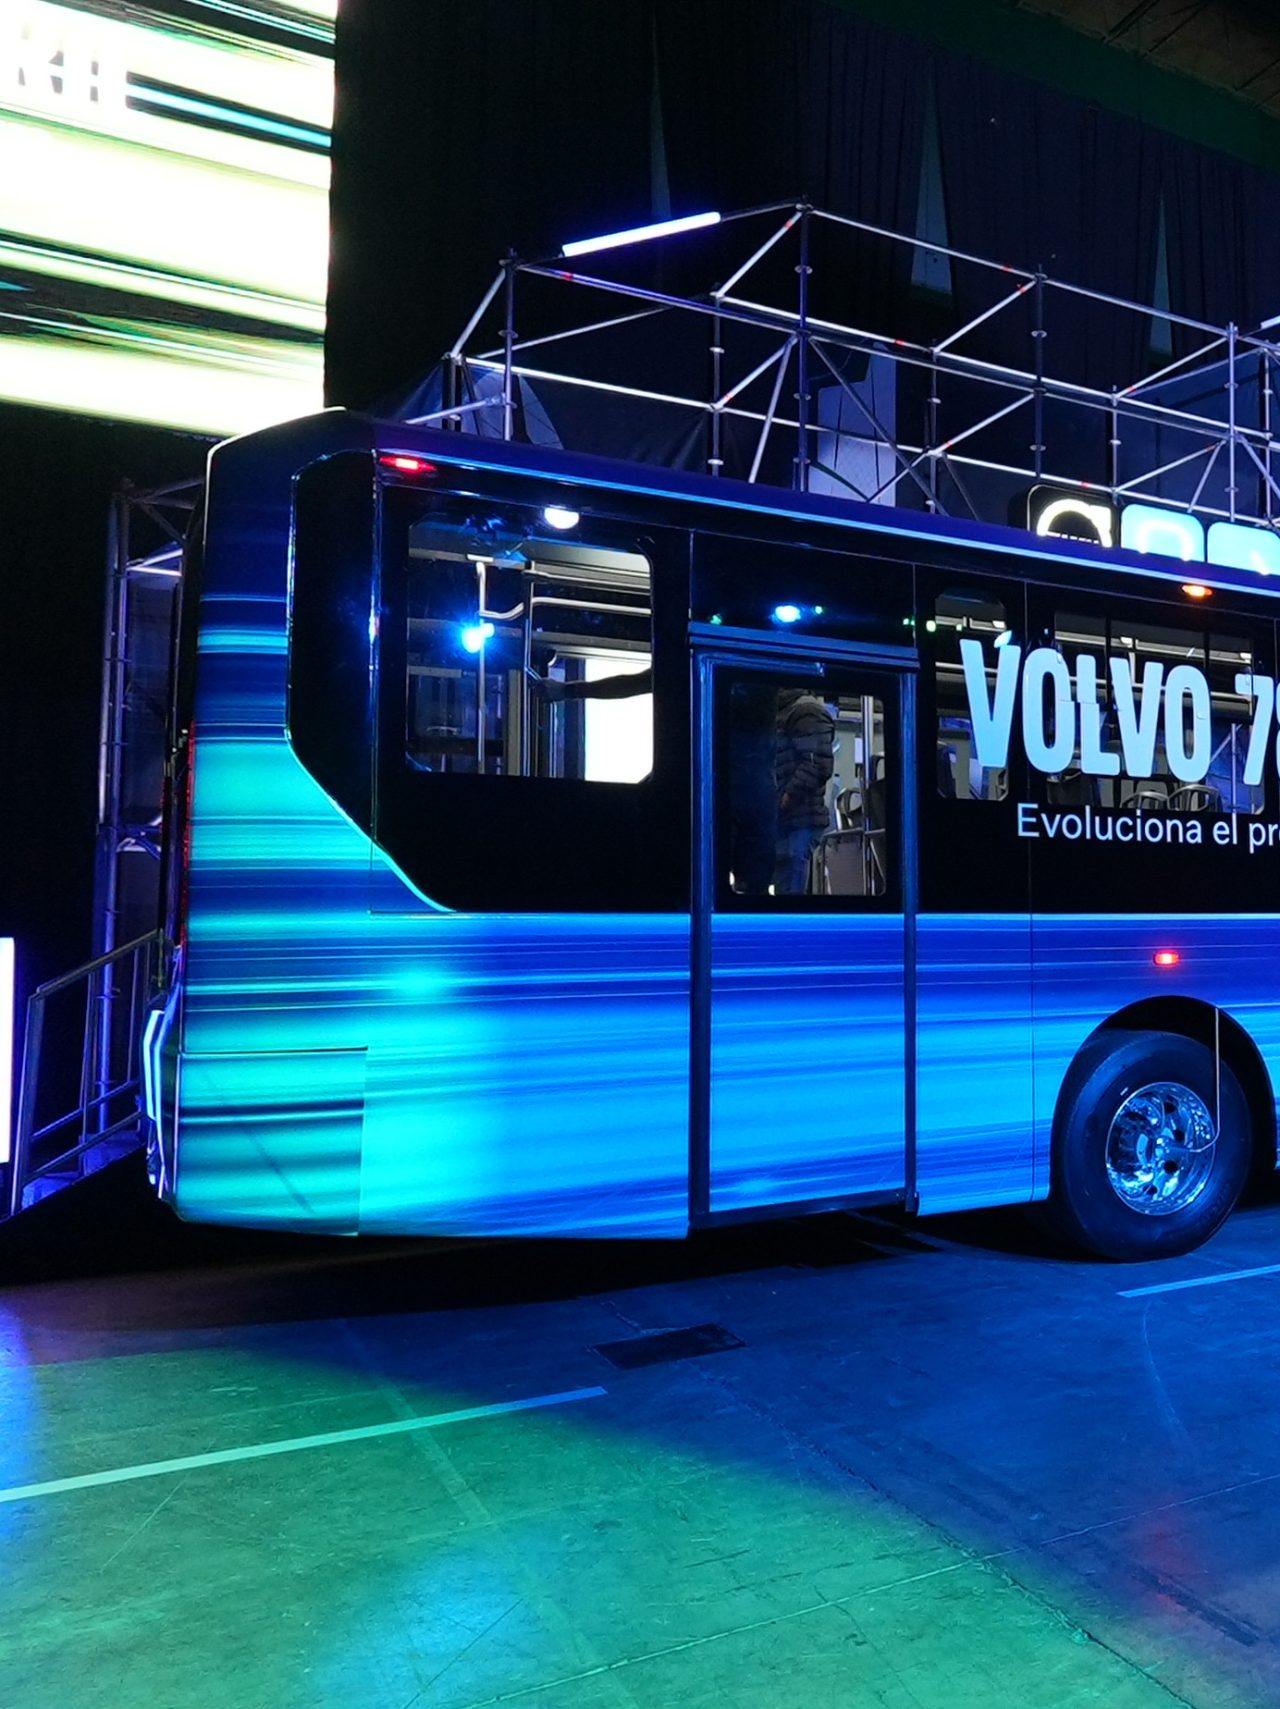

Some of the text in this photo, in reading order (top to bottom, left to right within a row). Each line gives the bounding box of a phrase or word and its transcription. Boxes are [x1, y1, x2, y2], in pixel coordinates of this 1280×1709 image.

[959, 638, 1212, 783] VOLVO
[1016, 803, 1203, 846] Evoluciona
[1212, 812, 1238, 845] el
